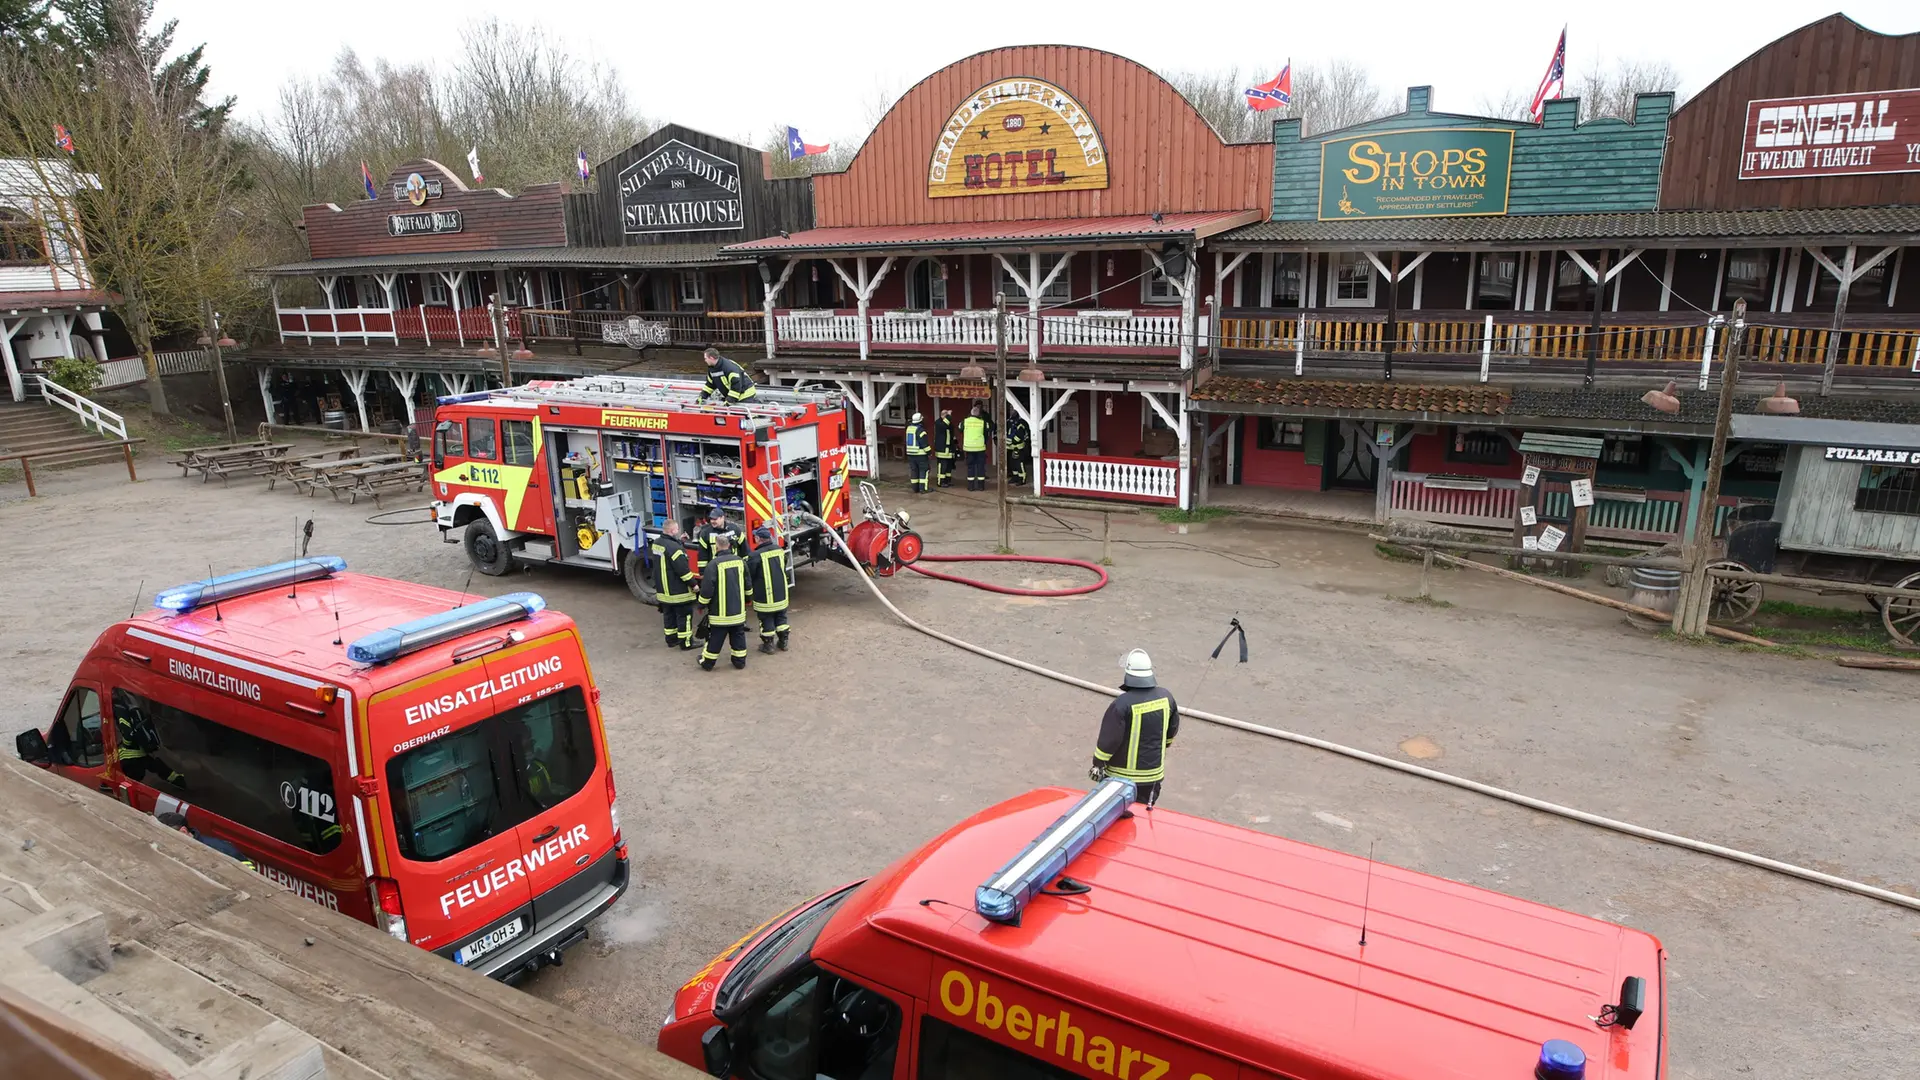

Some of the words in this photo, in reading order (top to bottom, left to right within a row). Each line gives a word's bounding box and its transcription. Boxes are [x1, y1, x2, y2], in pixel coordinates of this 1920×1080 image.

[931, 106, 973, 181] GRAND
[978, 83, 1056, 109] SILVER
[1061, 102, 1102, 166] STAR
[1755, 99, 1898, 148] GENERAL
[963, 148, 1065, 189] HOTEL
[1341, 141, 1488, 184] SHOPS
[1744, 152, 1757, 171] IF
[1759, 150, 1781, 170] WE
[1822, 146, 1858, 167] HAVE
[1858, 145, 1876, 166] IT
[621, 151, 673, 198] SILVER
[675, 150, 739, 194] SADDLE
[671, 180, 686, 189] 1881
[1382, 175, 1405, 191] IN
[1414, 174, 1486, 190] TOWN
[392, 215, 431, 235] BUFFALO
[626, 199, 740, 227] STEAKHOUSE
[929, 386, 990, 398] HOTEL
[601, 410, 669, 430] FEUERWEHR
[1825, 447, 1910, 463] PULLMAN
[481, 467, 500, 484] 112
[169, 658, 261, 701] EINSATZLEITUNG
[404, 655, 563, 725] EINSATZLEITUNG
[518, 693, 532, 705] HZ
[393, 725, 451, 753] OBERHARZ
[298, 786, 336, 824] 112
[439, 823, 590, 916] FEUERWEHR
[469, 938, 486, 956] WR
[492, 926, 508, 945] OH
[509, 923, 516, 935] 3
[939, 970, 1171, 1080] Oberharz
